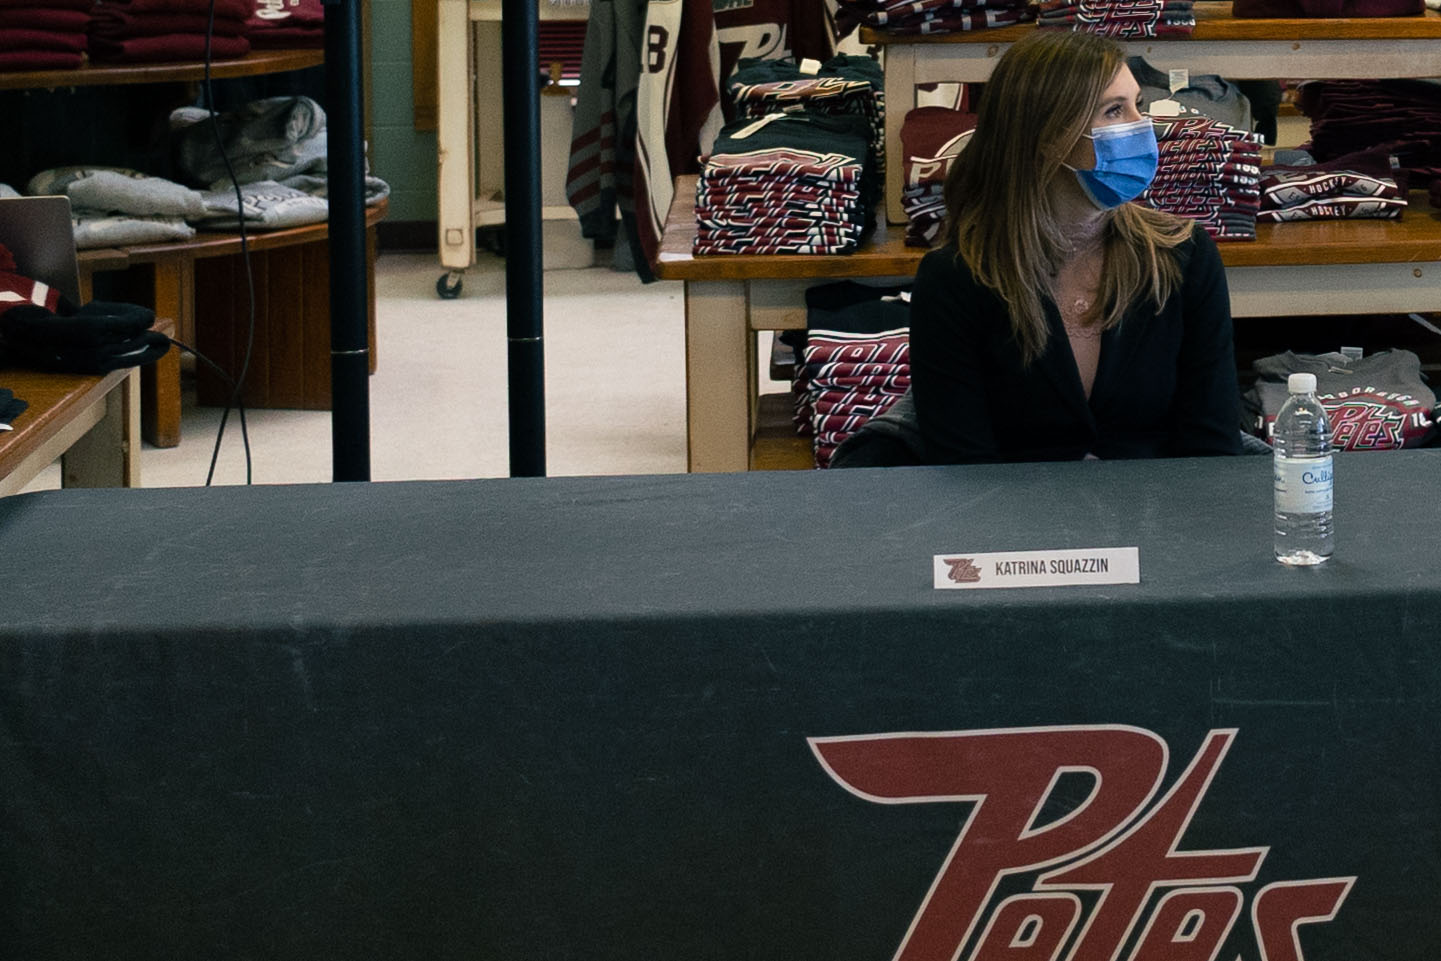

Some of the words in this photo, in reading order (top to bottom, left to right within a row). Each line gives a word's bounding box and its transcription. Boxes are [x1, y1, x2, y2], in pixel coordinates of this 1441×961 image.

[1308, 176, 1347, 194] HOCKEY
[995, 560, 1046, 576] KATRINA
[1050, 557, 1109, 574] SQUAZZIN
